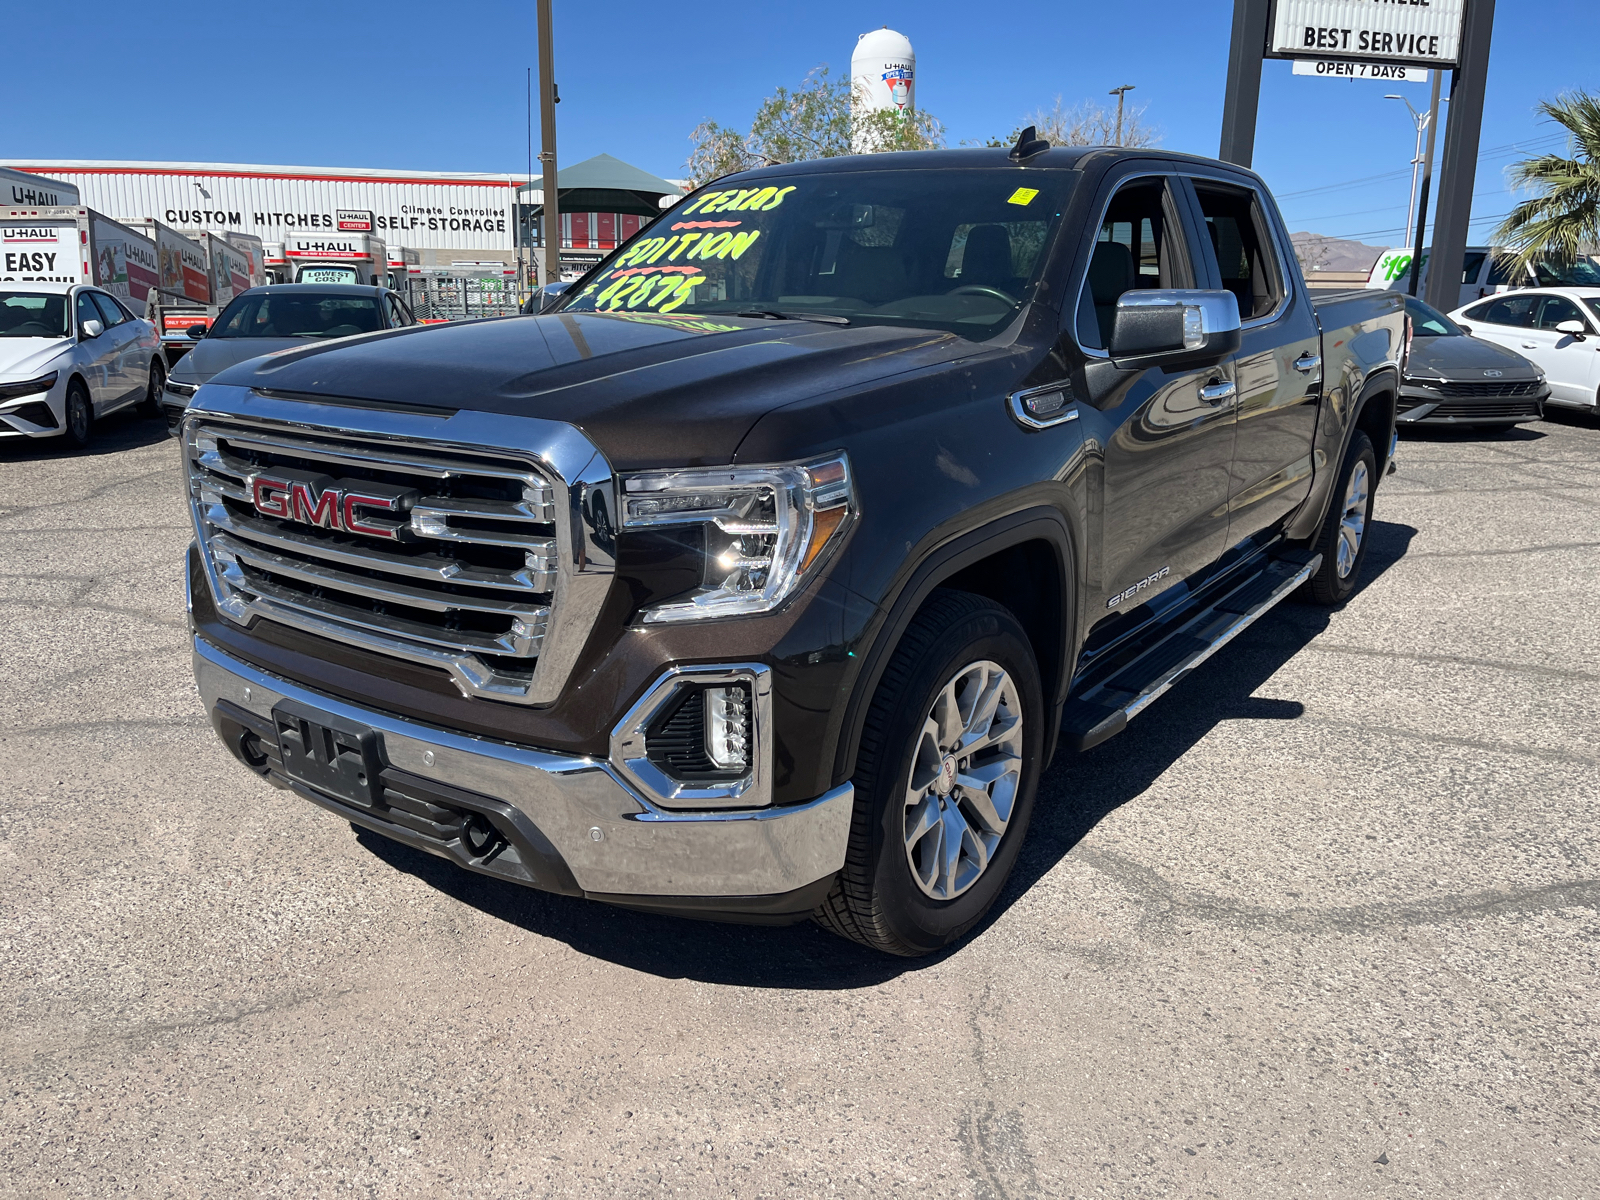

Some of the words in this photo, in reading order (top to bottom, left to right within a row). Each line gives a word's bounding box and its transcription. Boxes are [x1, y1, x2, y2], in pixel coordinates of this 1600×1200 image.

[1304, 27, 1351, 49] BEST
[1358, 30, 1439, 55] SERVICE
[884, 63, 912, 71] U-HAUL
[1316, 61, 1354, 75] OPEN
[1359, 64, 1368, 76] 7
[1371, 65, 1406, 78] DAYS
[12, 186, 58, 206] U-HAUL
[682, 185, 797, 215] TEXAS
[165, 210, 241, 226] CUSTOM
[254, 212, 333, 228] HITCHES
[339, 213, 369, 221] U-HAUL
[401, 205, 442, 215] Climate
[449, 206, 505, 217] Controlled
[4, 229, 57, 238] U-HAUL
[377, 215, 506, 233] SELF-STORAGE
[124, 242, 156, 269] U-HAUL
[297, 242, 356, 252] U-HAUL
[614, 230, 761, 269] EDITION
[5, 252, 57, 272] EASY
[181, 248, 205, 272] U-HAUL
[253, 476, 400, 541] GMC
[1106, 566, 1170, 609] SIERRA
